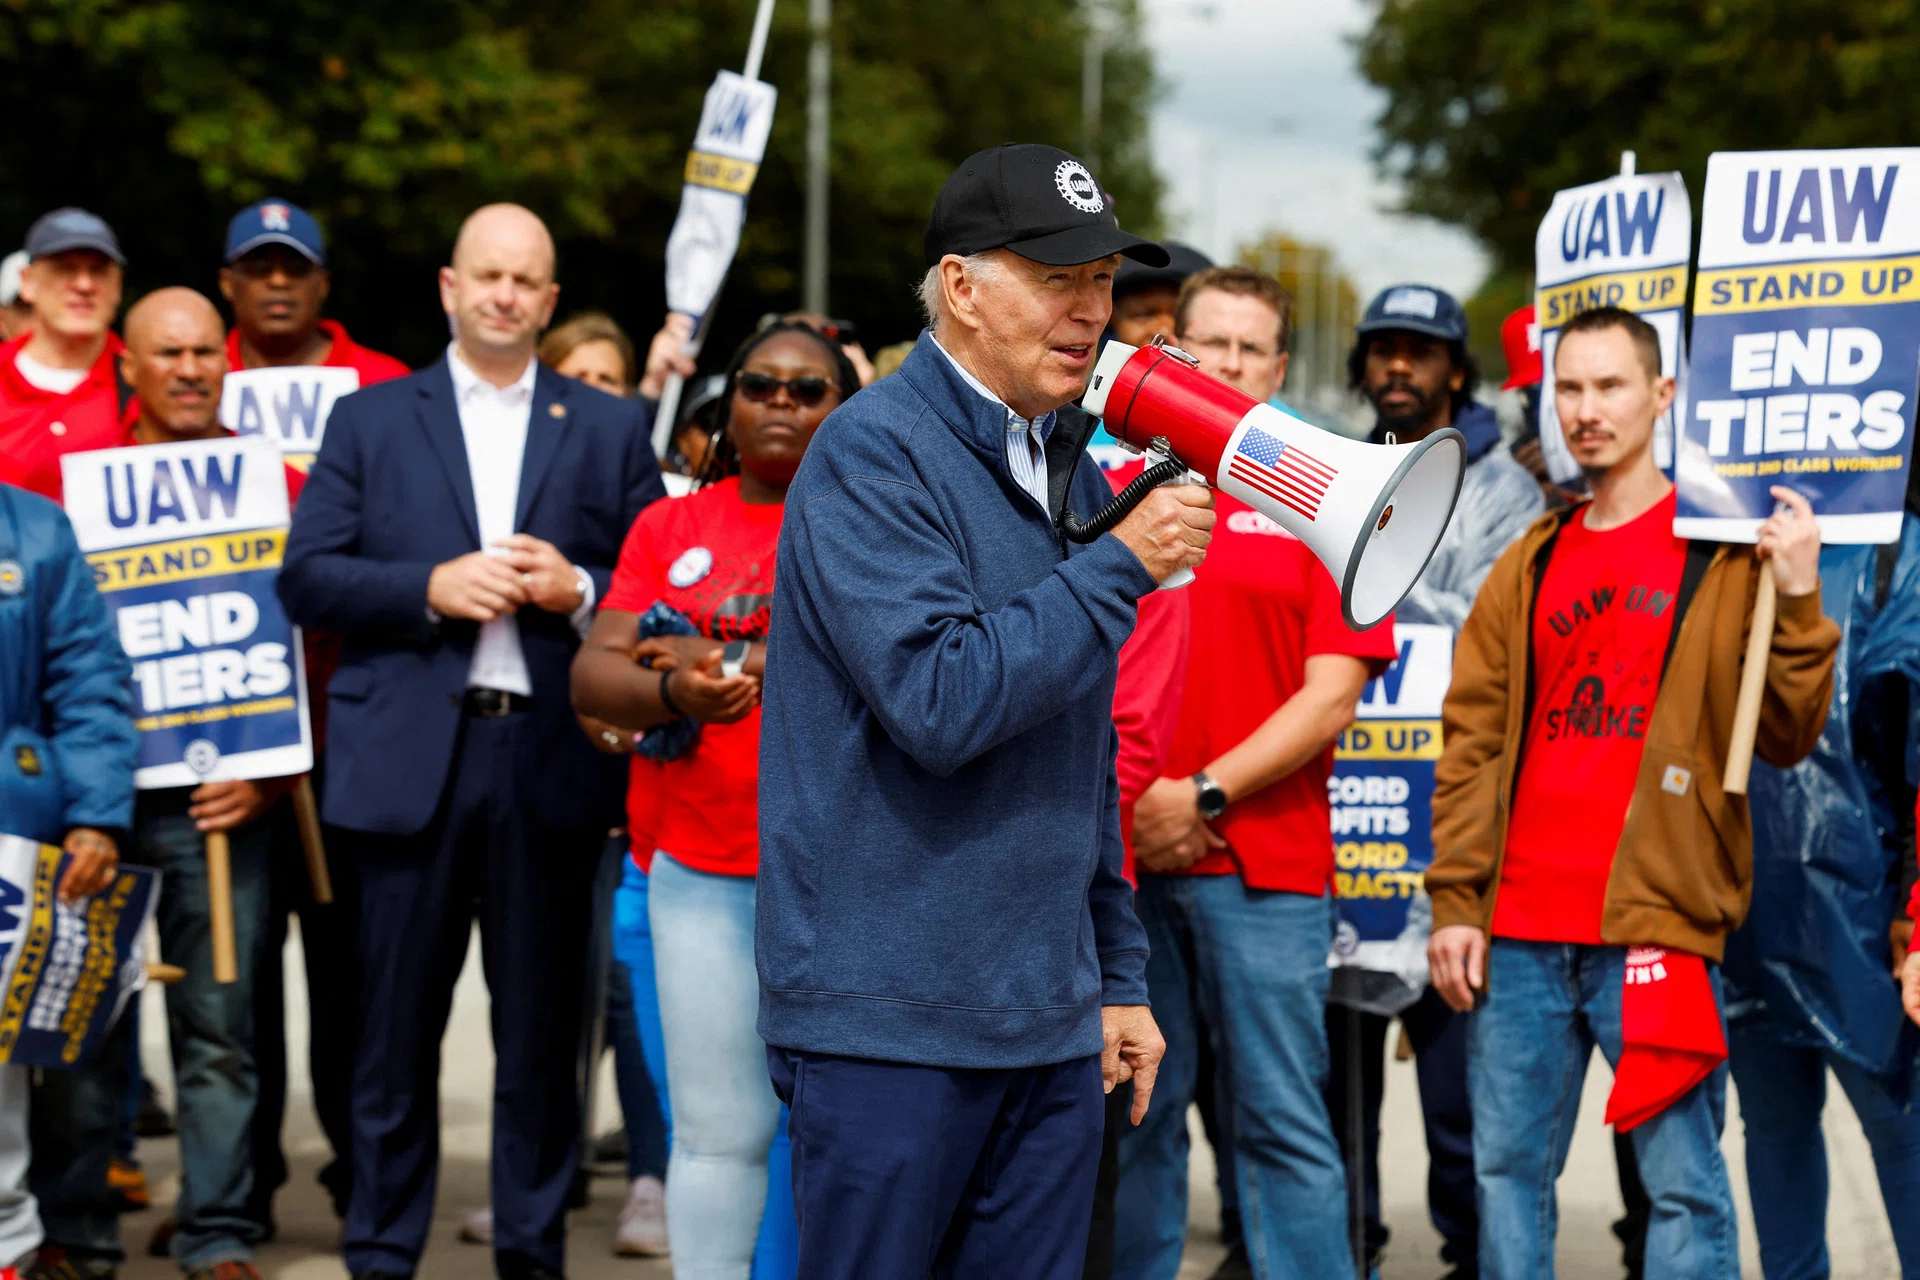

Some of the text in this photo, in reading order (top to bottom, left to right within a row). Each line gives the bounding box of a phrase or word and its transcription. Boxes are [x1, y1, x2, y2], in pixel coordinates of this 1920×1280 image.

[1070, 180, 1092, 193] UAW
[1742, 165, 1899, 244] UAW
[1562, 187, 1665, 263] UAW
[1548, 276, 1675, 319] STAND UP
[1711, 267, 1913, 306] STAND UP
[1730, 327, 1883, 392] END
[238, 382, 323, 440] AW
[1696, 390, 1906, 457] TIERS
[1783, 457, 1831, 473] CLASS
[1833, 455, 1904, 472] WORKERS
[103, 454, 245, 529] UAW
[92, 539, 275, 584] STAND UP
[117, 590, 260, 657] END
[1547, 585, 1675, 637] UAW ON
[131, 641, 292, 713] IERS
[1385, 729, 1432, 752] UP
[1547, 704, 1647, 742] STRIKE
[1326, 775, 1411, 805] CORD
[1335, 841, 1409, 870] ORD
